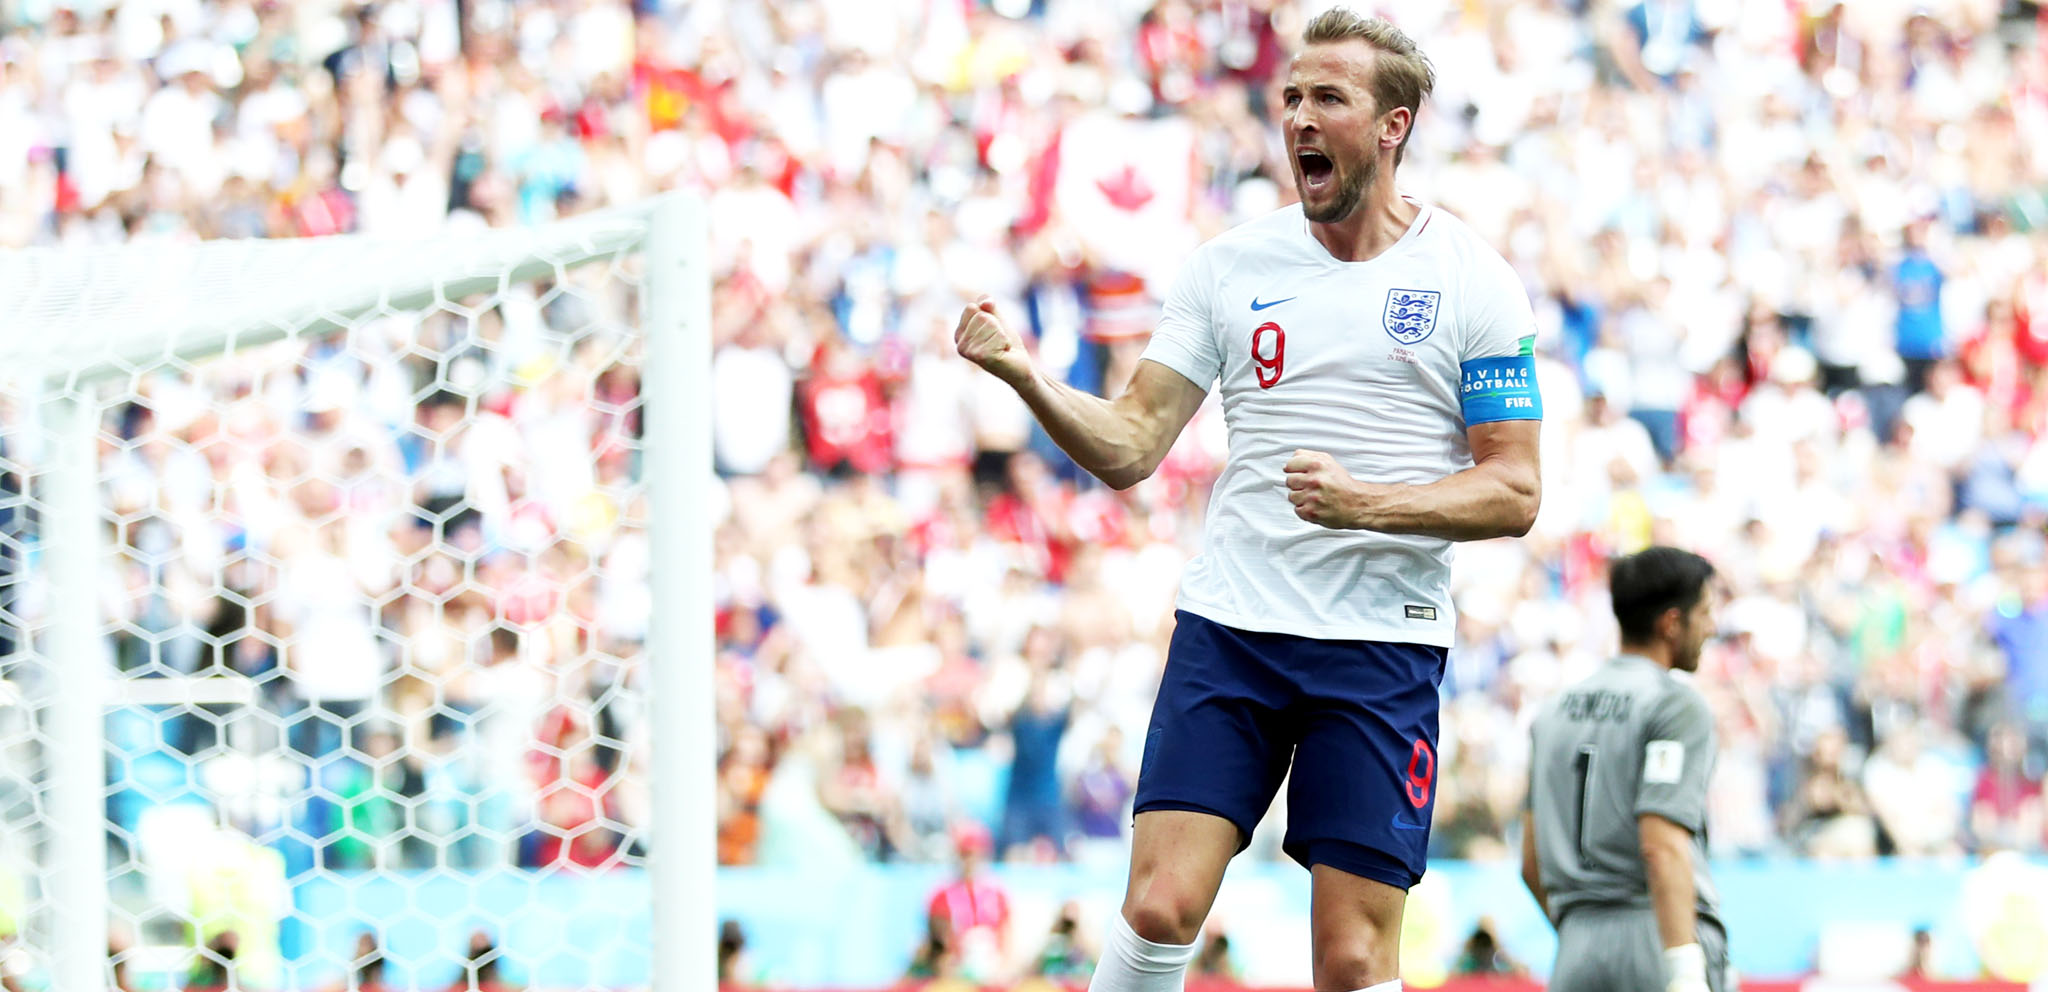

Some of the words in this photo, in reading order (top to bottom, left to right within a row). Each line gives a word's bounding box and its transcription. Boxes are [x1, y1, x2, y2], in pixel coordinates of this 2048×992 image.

[1251, 321, 1285, 390] 9
[1466, 368, 1528, 381] IVING
[1460, 378, 1528, 392] OOTBALL
[1504, 397, 1533, 408] FIFA
[1405, 738, 1434, 809] 9
[1572, 743, 1596, 870] 1
